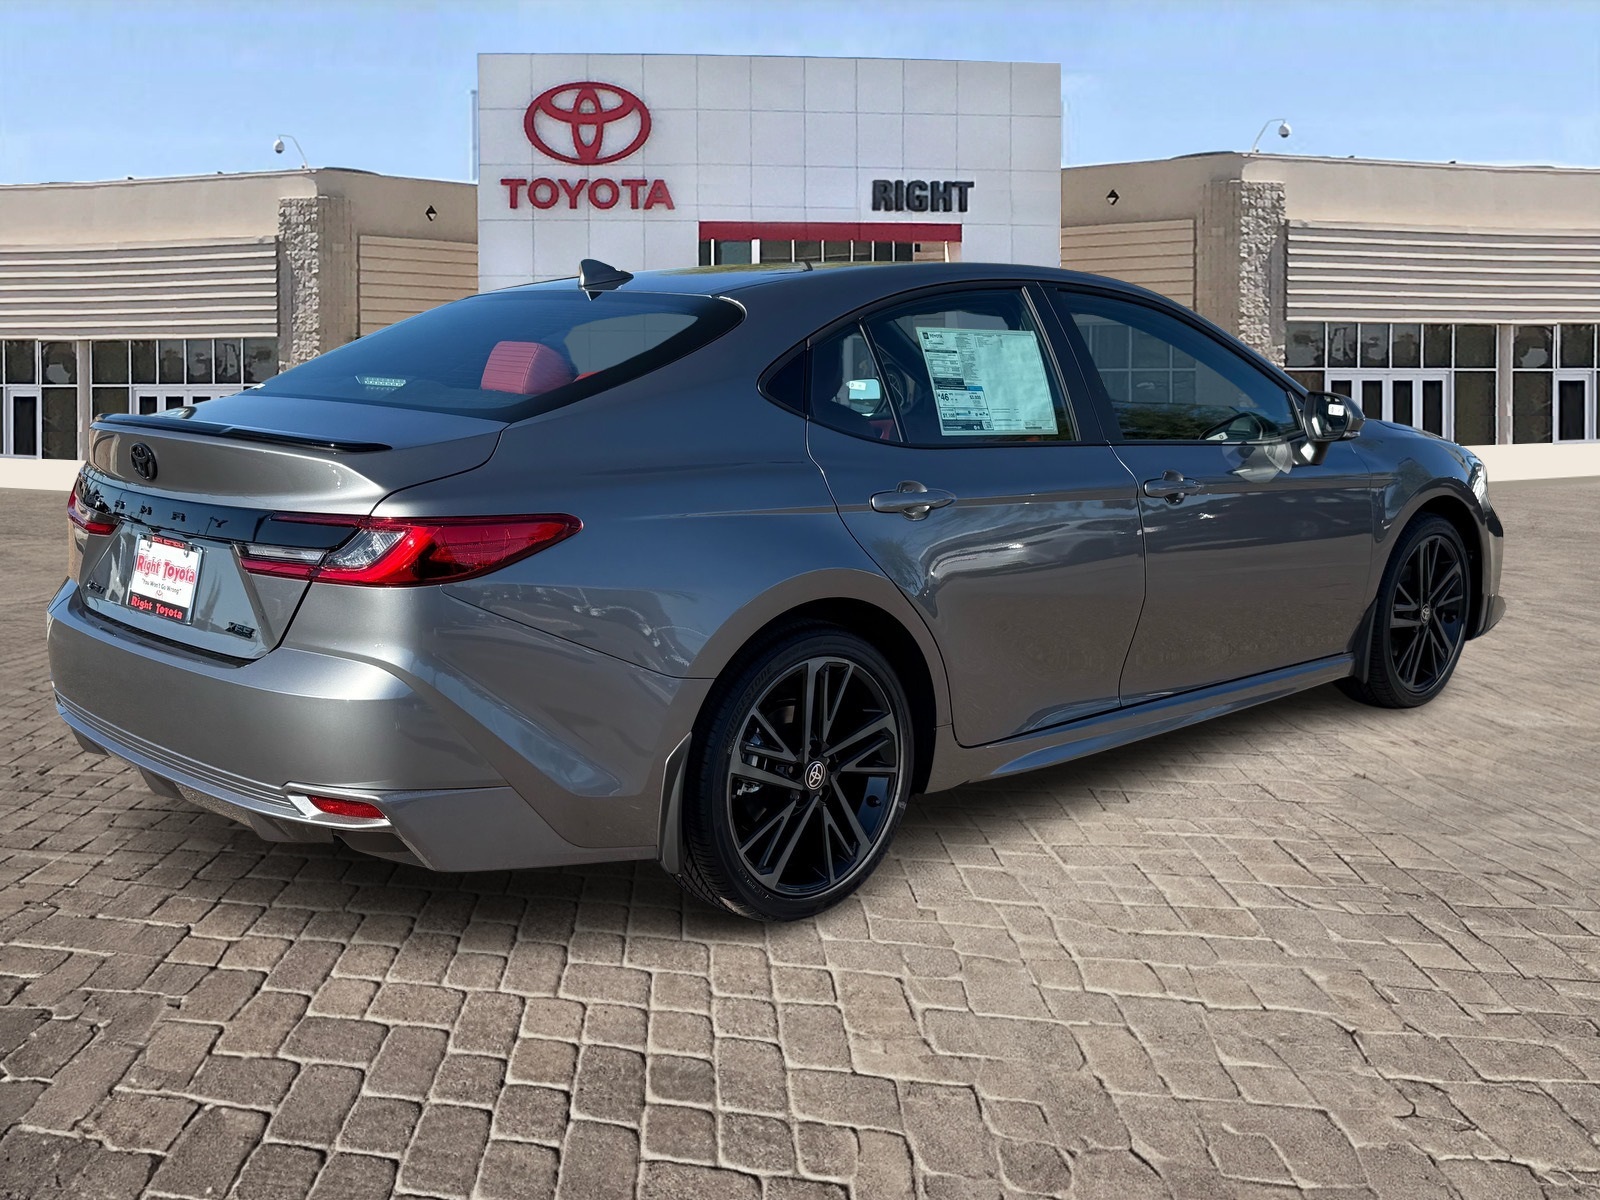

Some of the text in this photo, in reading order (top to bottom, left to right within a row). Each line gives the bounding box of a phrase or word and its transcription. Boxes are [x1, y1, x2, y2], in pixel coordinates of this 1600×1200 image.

[500, 177, 675, 210] TOYOTA
[872, 179, 975, 212] RIGHT
[94, 493, 229, 529] AMRY
[137, 554, 196, 583] Right Toyota
[131, 595, 183, 620] Right Toyota
